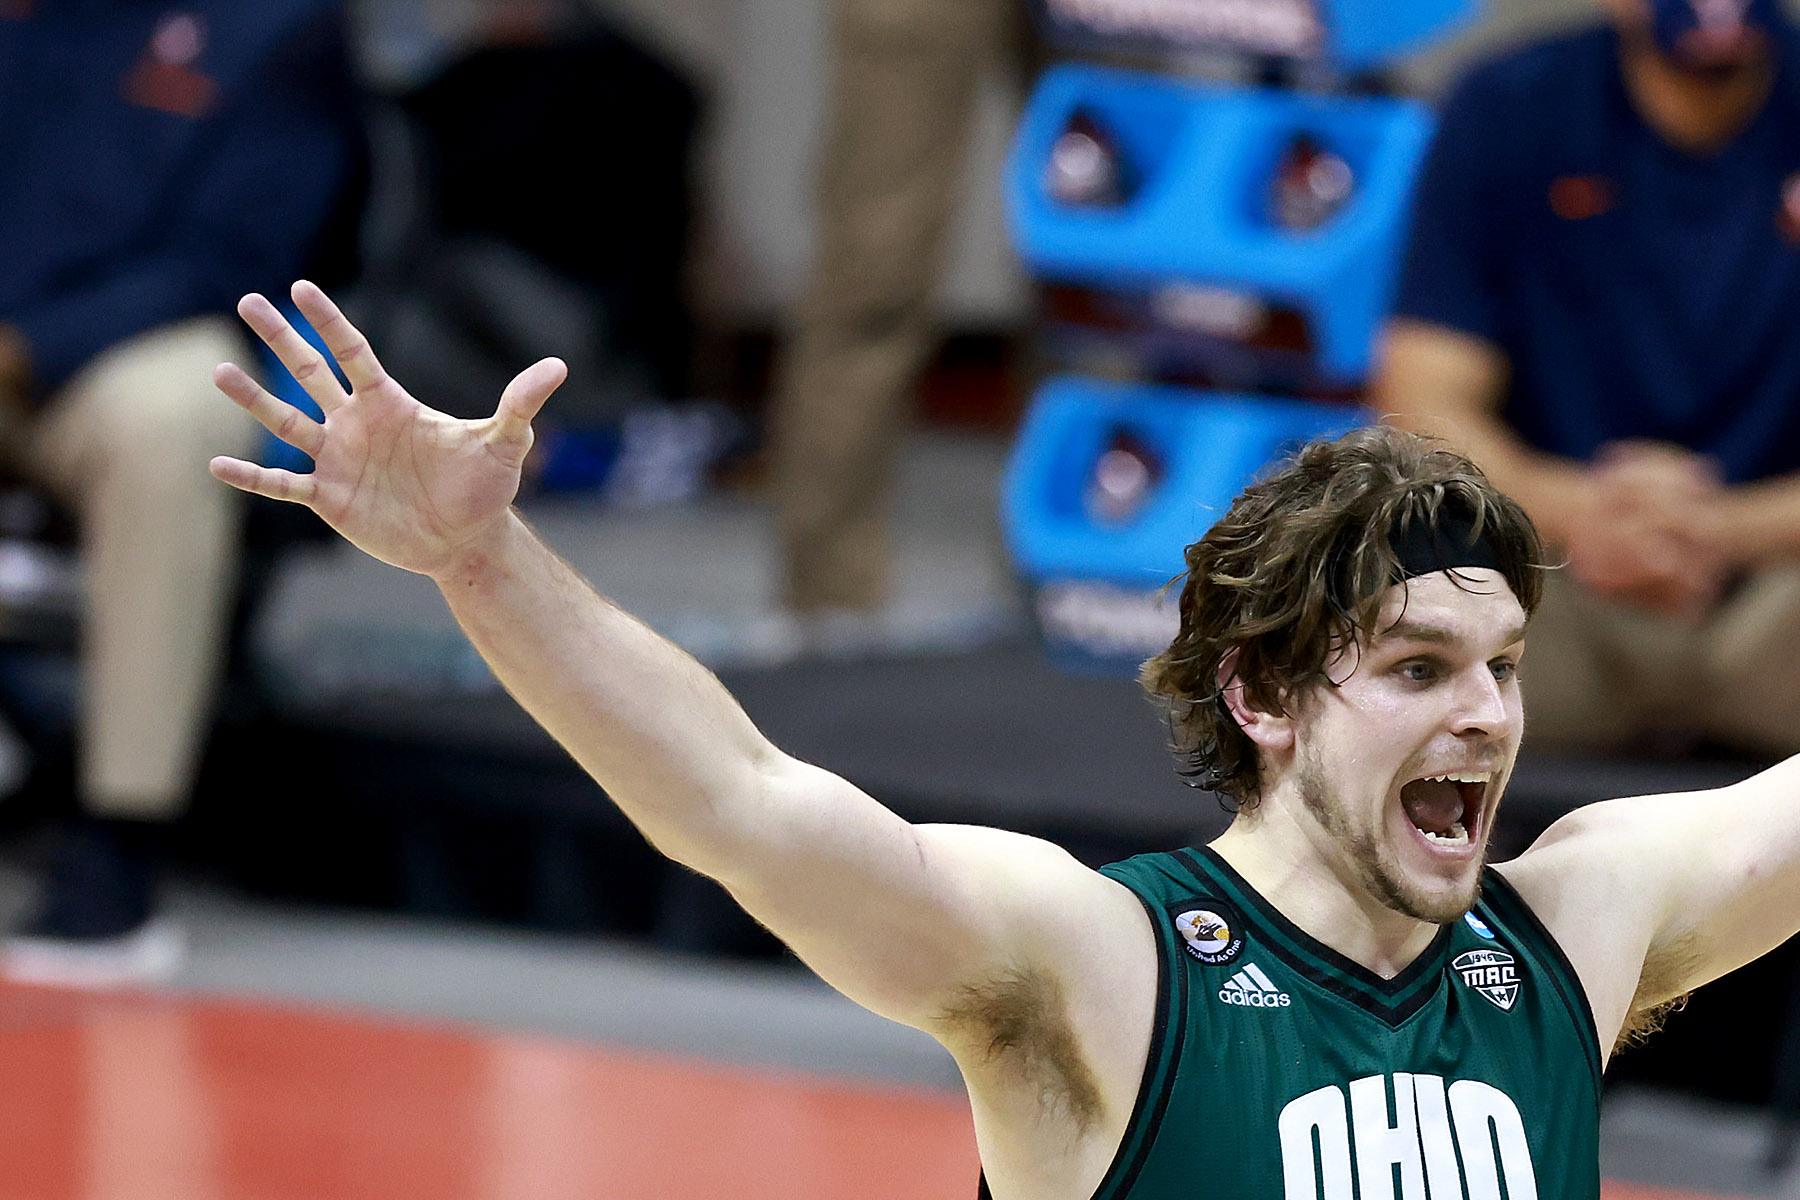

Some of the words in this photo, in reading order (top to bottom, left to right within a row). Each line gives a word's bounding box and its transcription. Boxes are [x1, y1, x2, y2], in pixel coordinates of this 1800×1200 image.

[1217, 954, 1229, 963] As
[1226, 939, 1242, 956] One
[1472, 953, 1493, 963] 1946
[1462, 966, 1521, 987] MAC
[1218, 988, 1291, 1008] adidas
